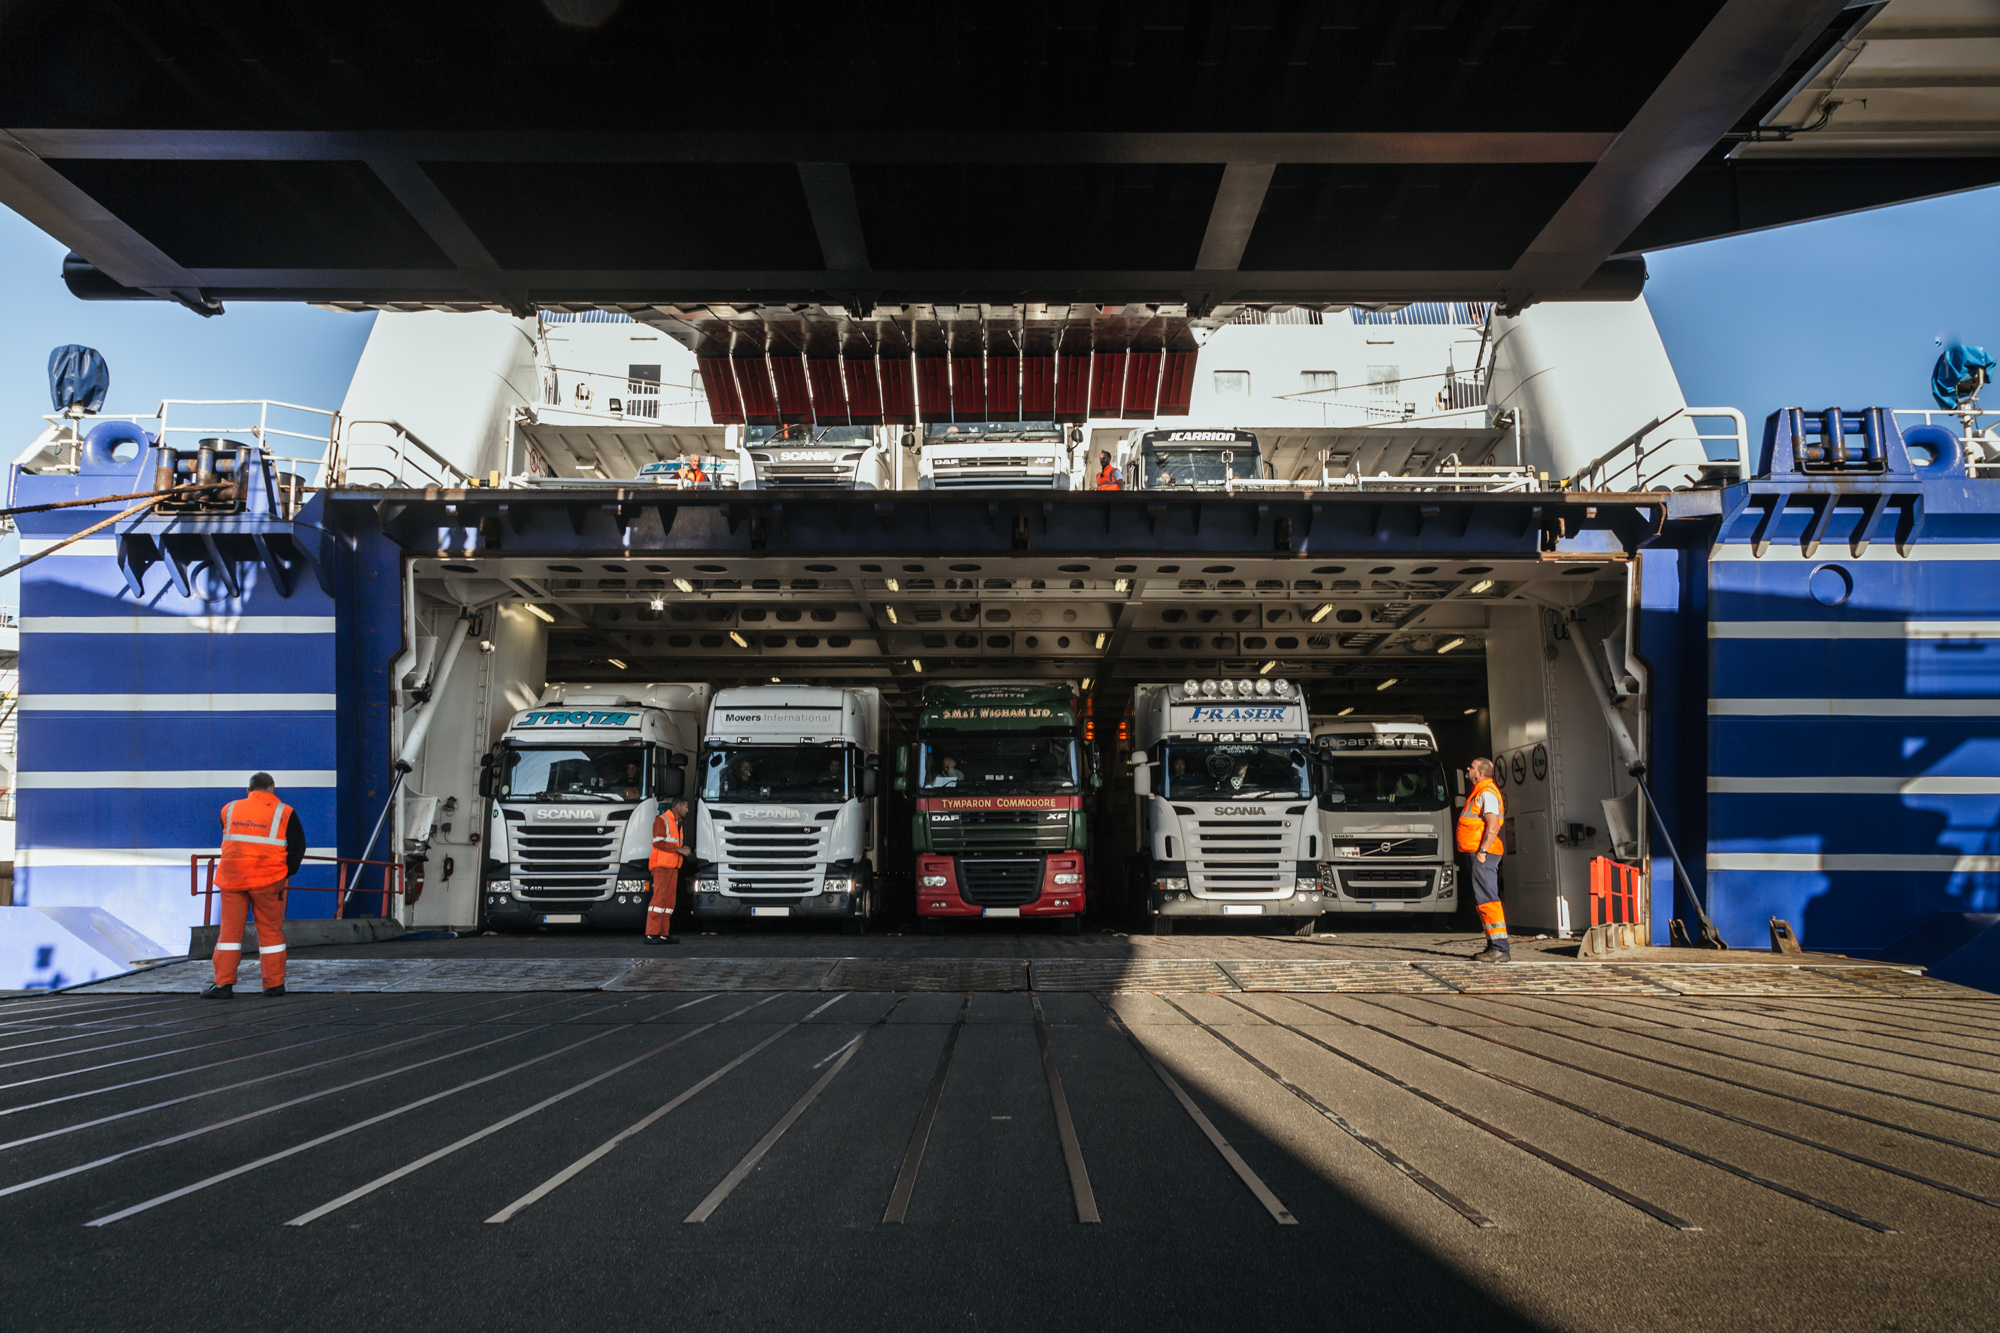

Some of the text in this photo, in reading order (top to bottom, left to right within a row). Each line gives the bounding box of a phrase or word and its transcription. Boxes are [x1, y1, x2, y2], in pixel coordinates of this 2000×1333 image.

[1168, 431, 1236, 442] JCARRION
[780, 451, 832, 461] SCANIA
[725, 714, 831, 722] Movers International
[980, 708, 1027, 718] WIGHAM
[1188, 706, 1287, 720] FRASER
[516, 711, 640, 726] TROTA
[1320, 738, 1429, 748] GLOBETROTTER
[941, 798, 1056, 808] TYMPARON COMMODORE
[536, 809, 595, 820] SCANIA
[744, 809, 801, 819] SCANIA
[1214, 806, 1267, 816] SCANIA
